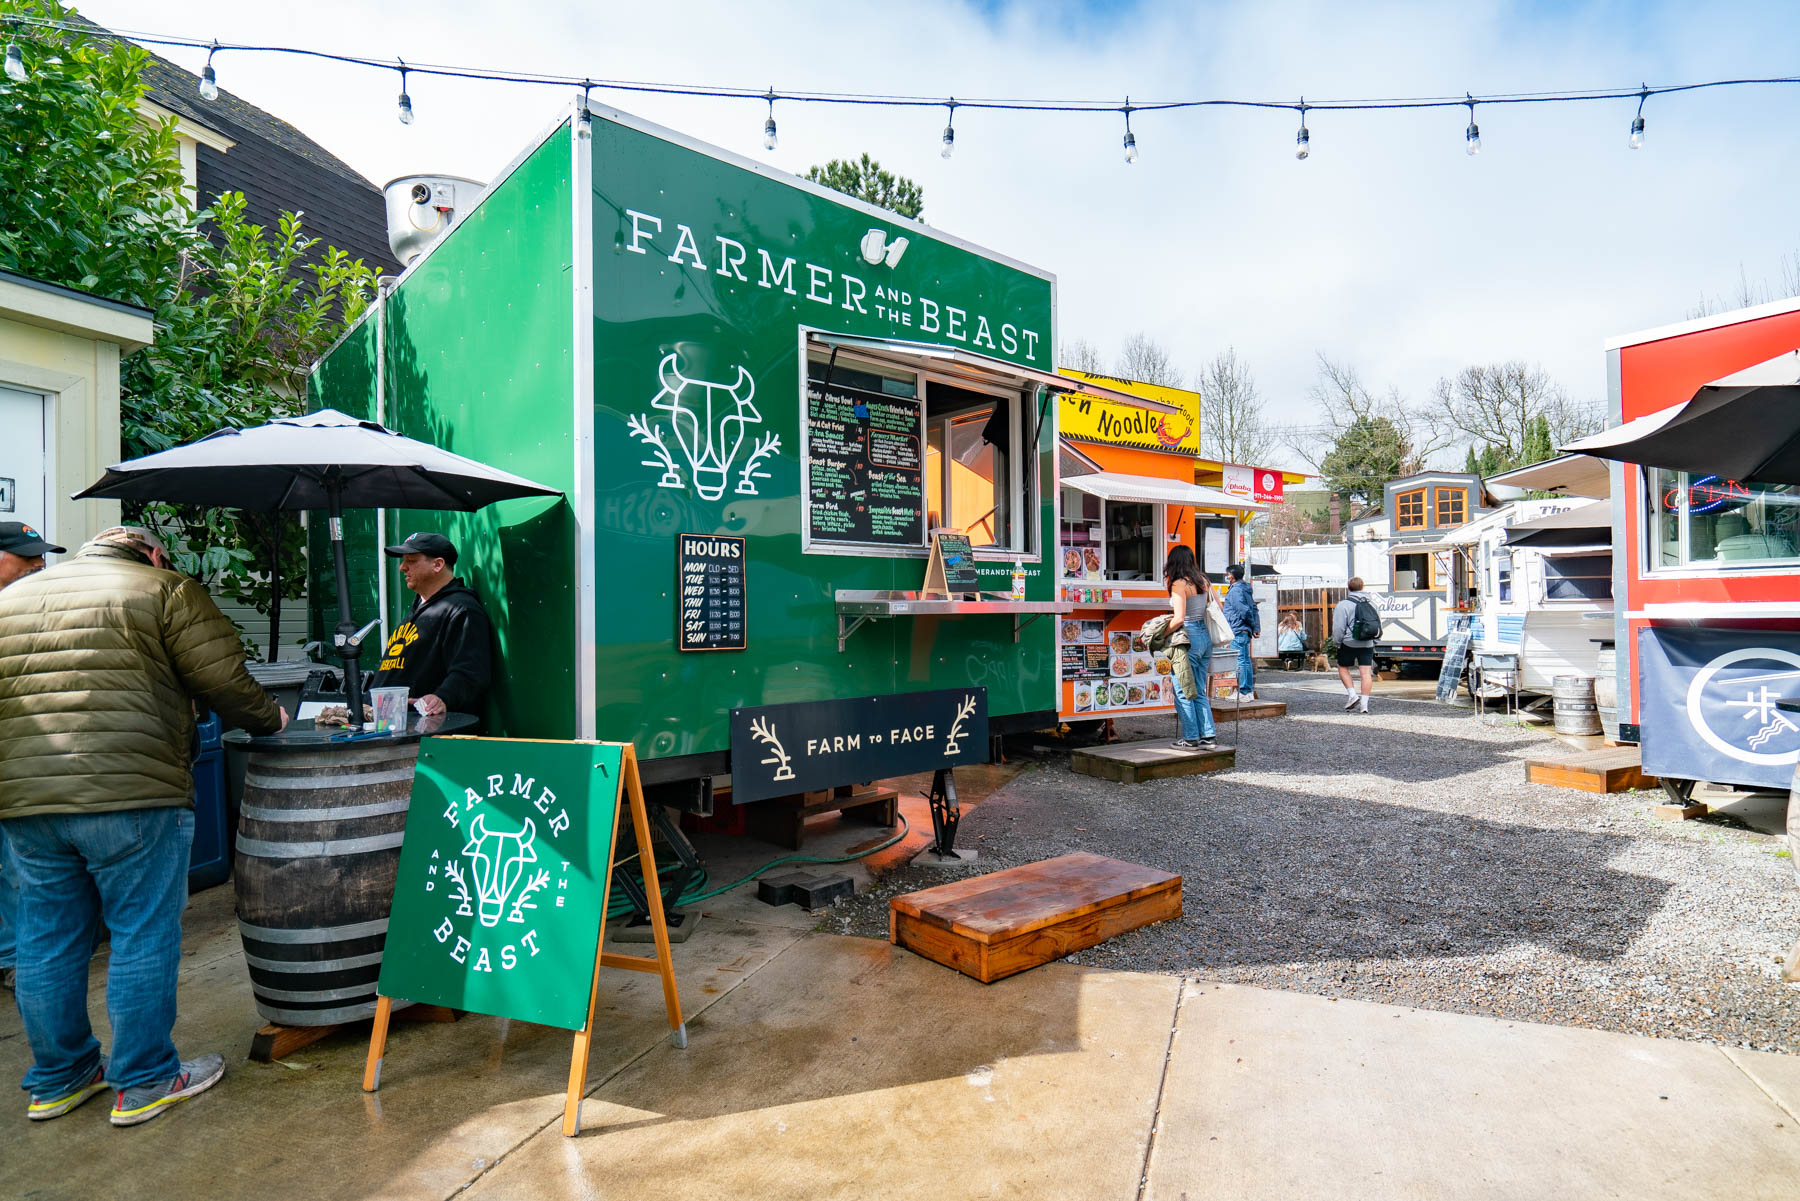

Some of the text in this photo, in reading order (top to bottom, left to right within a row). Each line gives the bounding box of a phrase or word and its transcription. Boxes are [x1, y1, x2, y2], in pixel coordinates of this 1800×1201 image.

[626, 209, 1039, 361] FARMER AND BEAST
[875, 305, 912, 326] THE
[1097, 410, 1158, 437] Noodle
[808, 428, 824, 438] Etra
[808, 456, 825, 466] Beast
[826, 458, 847, 470] Burger
[868, 470, 884, 481] Beast
[825, 501, 839, 511] Bird
[1539, 505, 1571, 515] The
[685, 540, 740, 558] HOURS
[684, 562, 706, 573] MON
[685, 574, 704, 584] TUE
[684, 586, 705, 596] WED
[684, 598, 704, 608] THU
[1379, 597, 1412, 612] aken
[684, 609, 702, 620] FRI
[685, 621, 705, 632] SAT
[686, 633, 707, 643] SUN
[807, 725, 935, 756] FARM TO FACE
[443, 773, 570, 838] FARMER
[426, 849, 439, 892] AND
[555, 861, 570, 907] THE
[433, 917, 540, 972] BEAST
